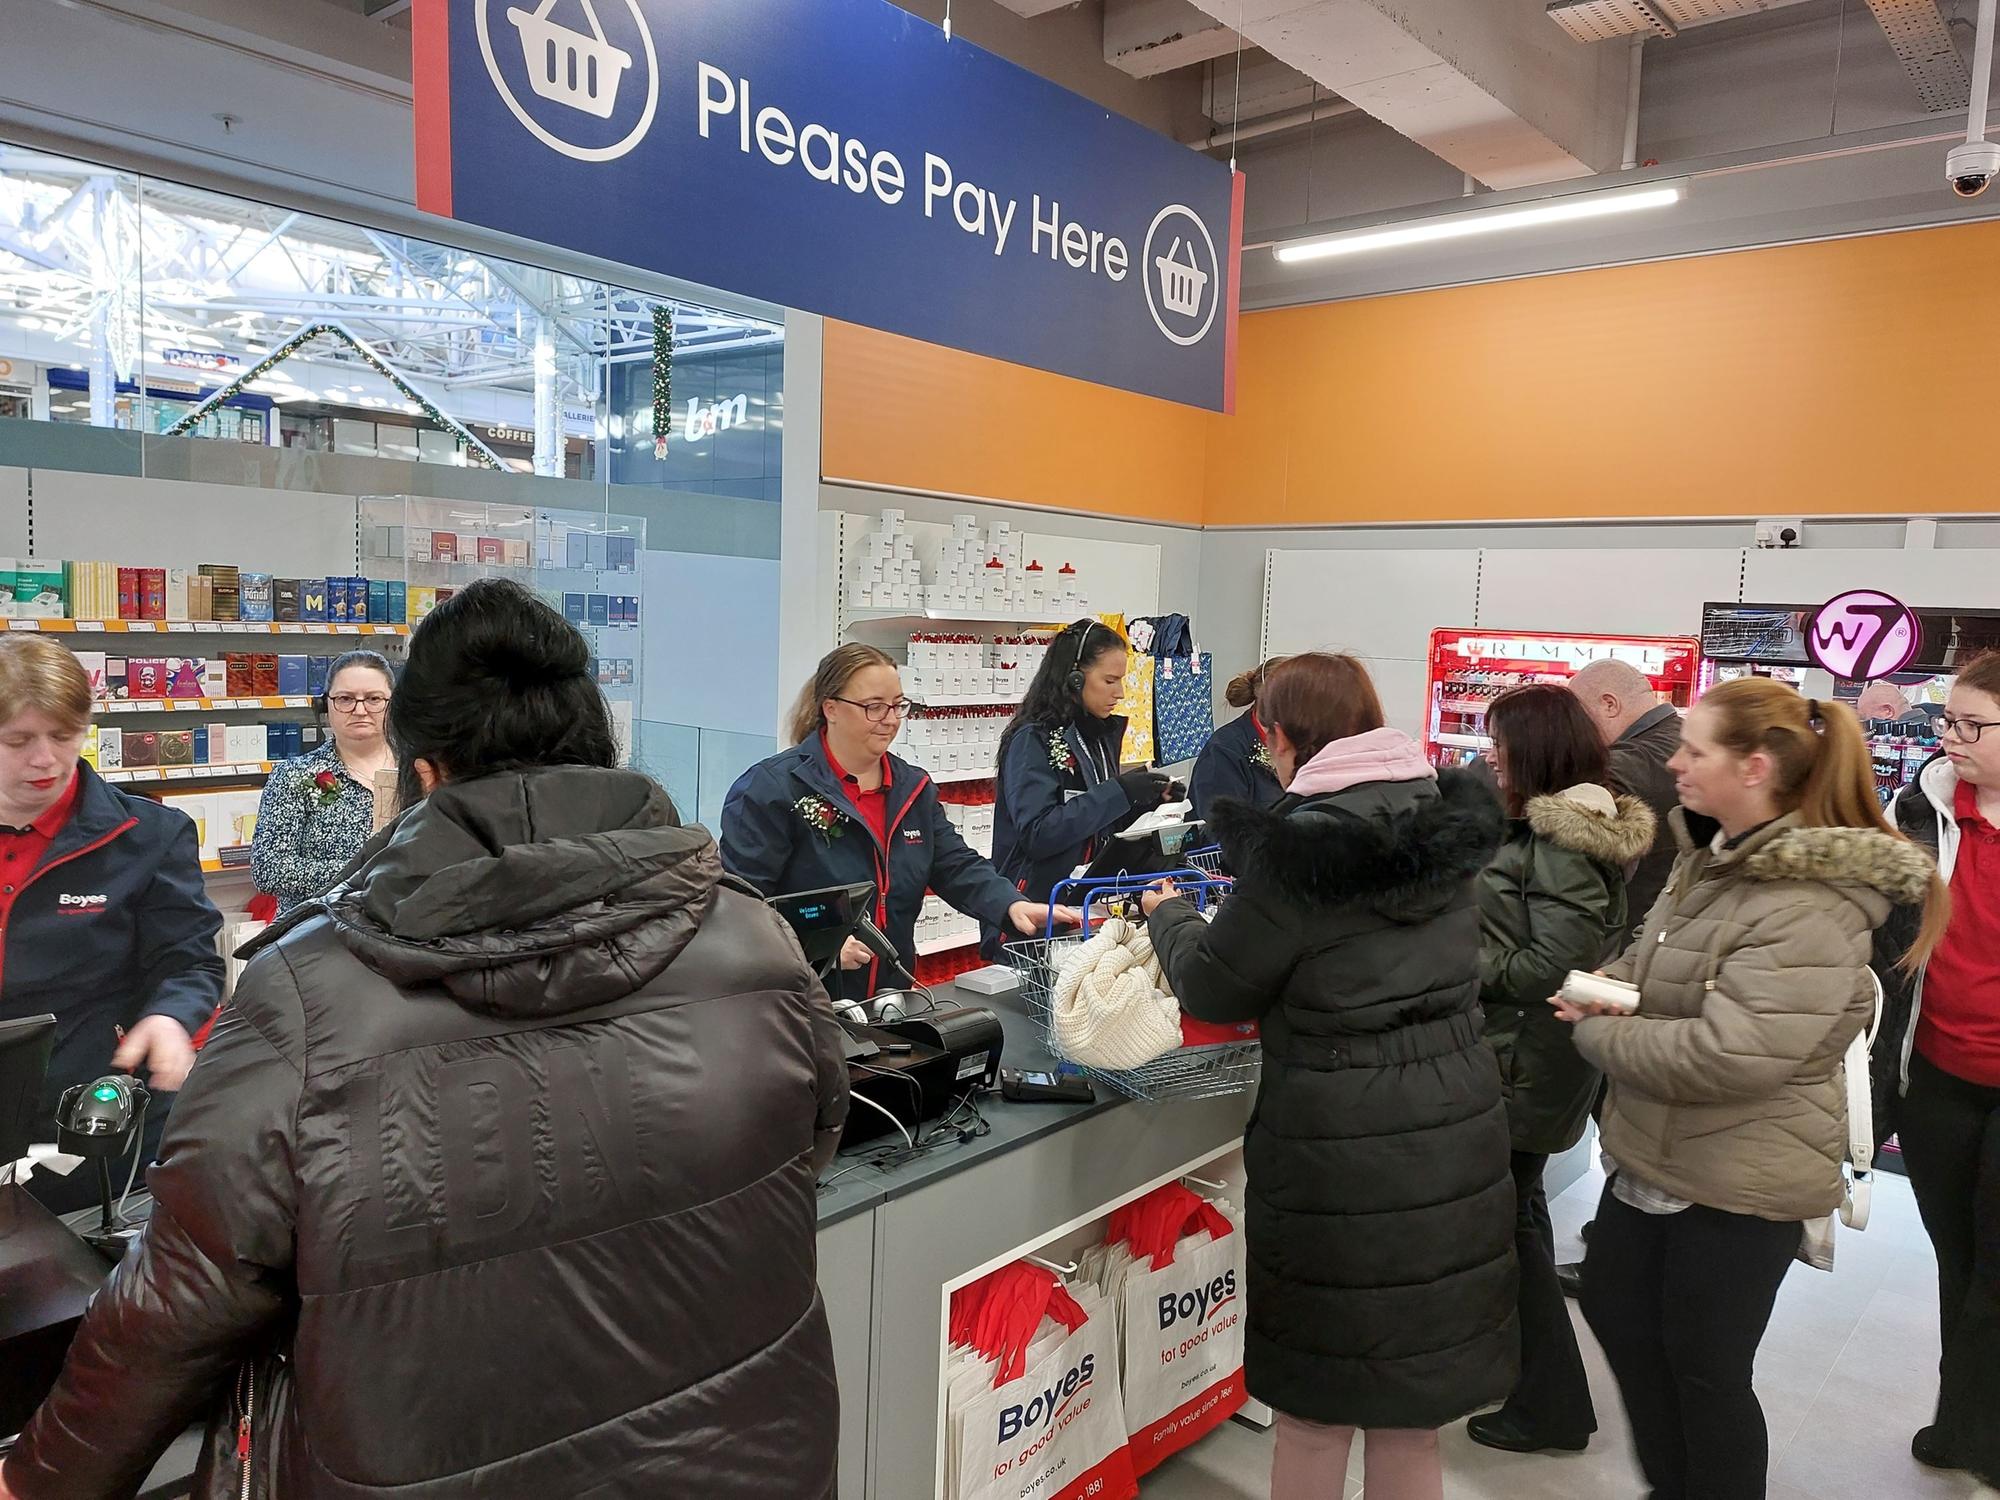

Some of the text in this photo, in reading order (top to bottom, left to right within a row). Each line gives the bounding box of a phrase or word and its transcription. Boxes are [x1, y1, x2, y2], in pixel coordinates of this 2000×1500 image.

[698, 60, 1128, 281] Please Pay Here
[487, 427, 533, 443] COFFEE
[563, 411, 596, 422] ALLERIE
[684, 393, 747, 441] b&m
[1492, 642, 1658, 664] RIMMEL
[58, 893, 108, 907] Boyes
[1159, 1268, 1236, 1331] Boyes
[1161, 1313, 1238, 1366] for good value
[998, 1353, 1095, 1446] Boyes
[1153, 1420, 1179, 1445] Family
[1179, 1409, 1201, 1427] value
[1201, 1395, 1219, 1414] since
[993, 1397, 1091, 1480] for good value
[1020, 1456, 1067, 1499] boyes.co.uk
[1085, 1477, 1104, 1498] 1881
